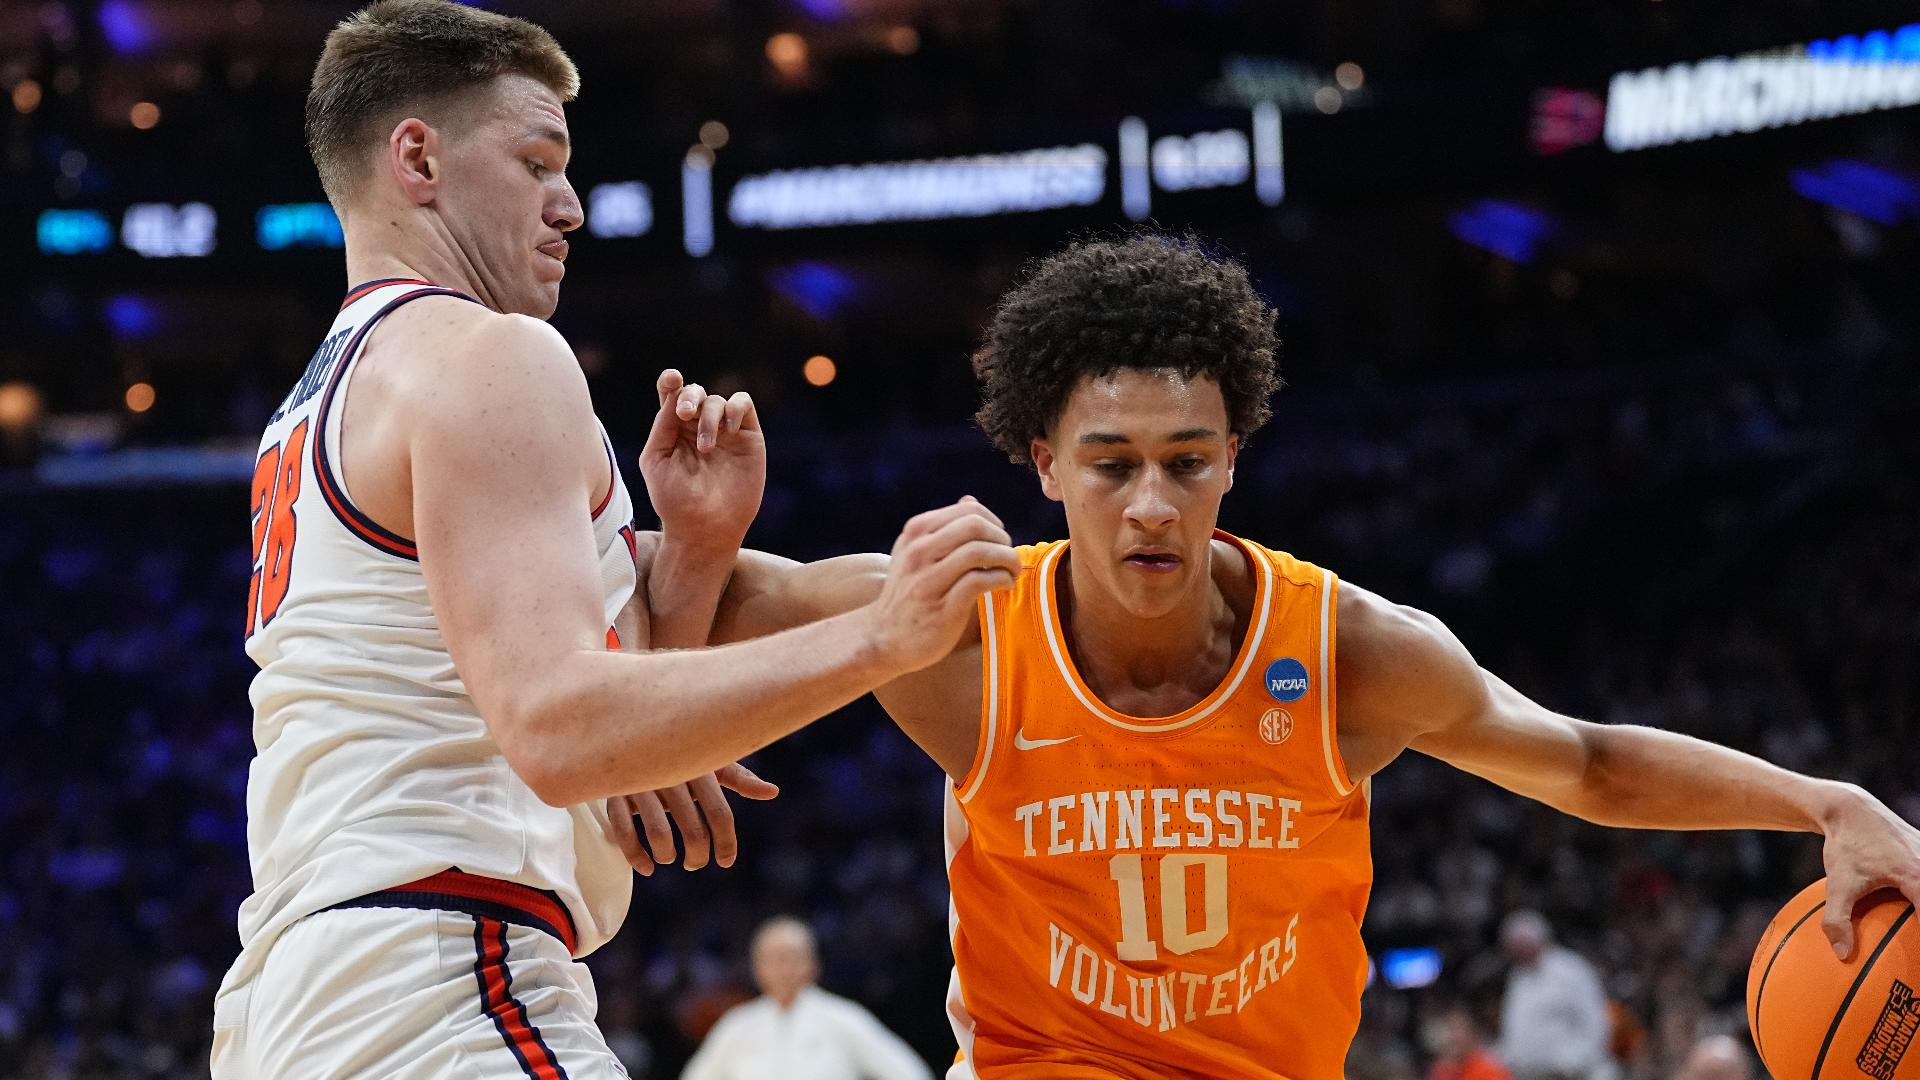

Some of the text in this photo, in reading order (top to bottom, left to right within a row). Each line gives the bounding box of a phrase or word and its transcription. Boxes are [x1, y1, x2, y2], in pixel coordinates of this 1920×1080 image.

[1271, 678, 1307, 692] NCAA
[1262, 710, 1291, 742] SEC
[1015, 788, 1302, 858] TENNESSEE
[1109, 853, 1229, 961] 10
[1049, 912, 1299, 1033] VOLUNTEERS
[1860, 1009, 1902, 1074] MADNESS
[1885, 1010, 1919, 1063] MARCH
